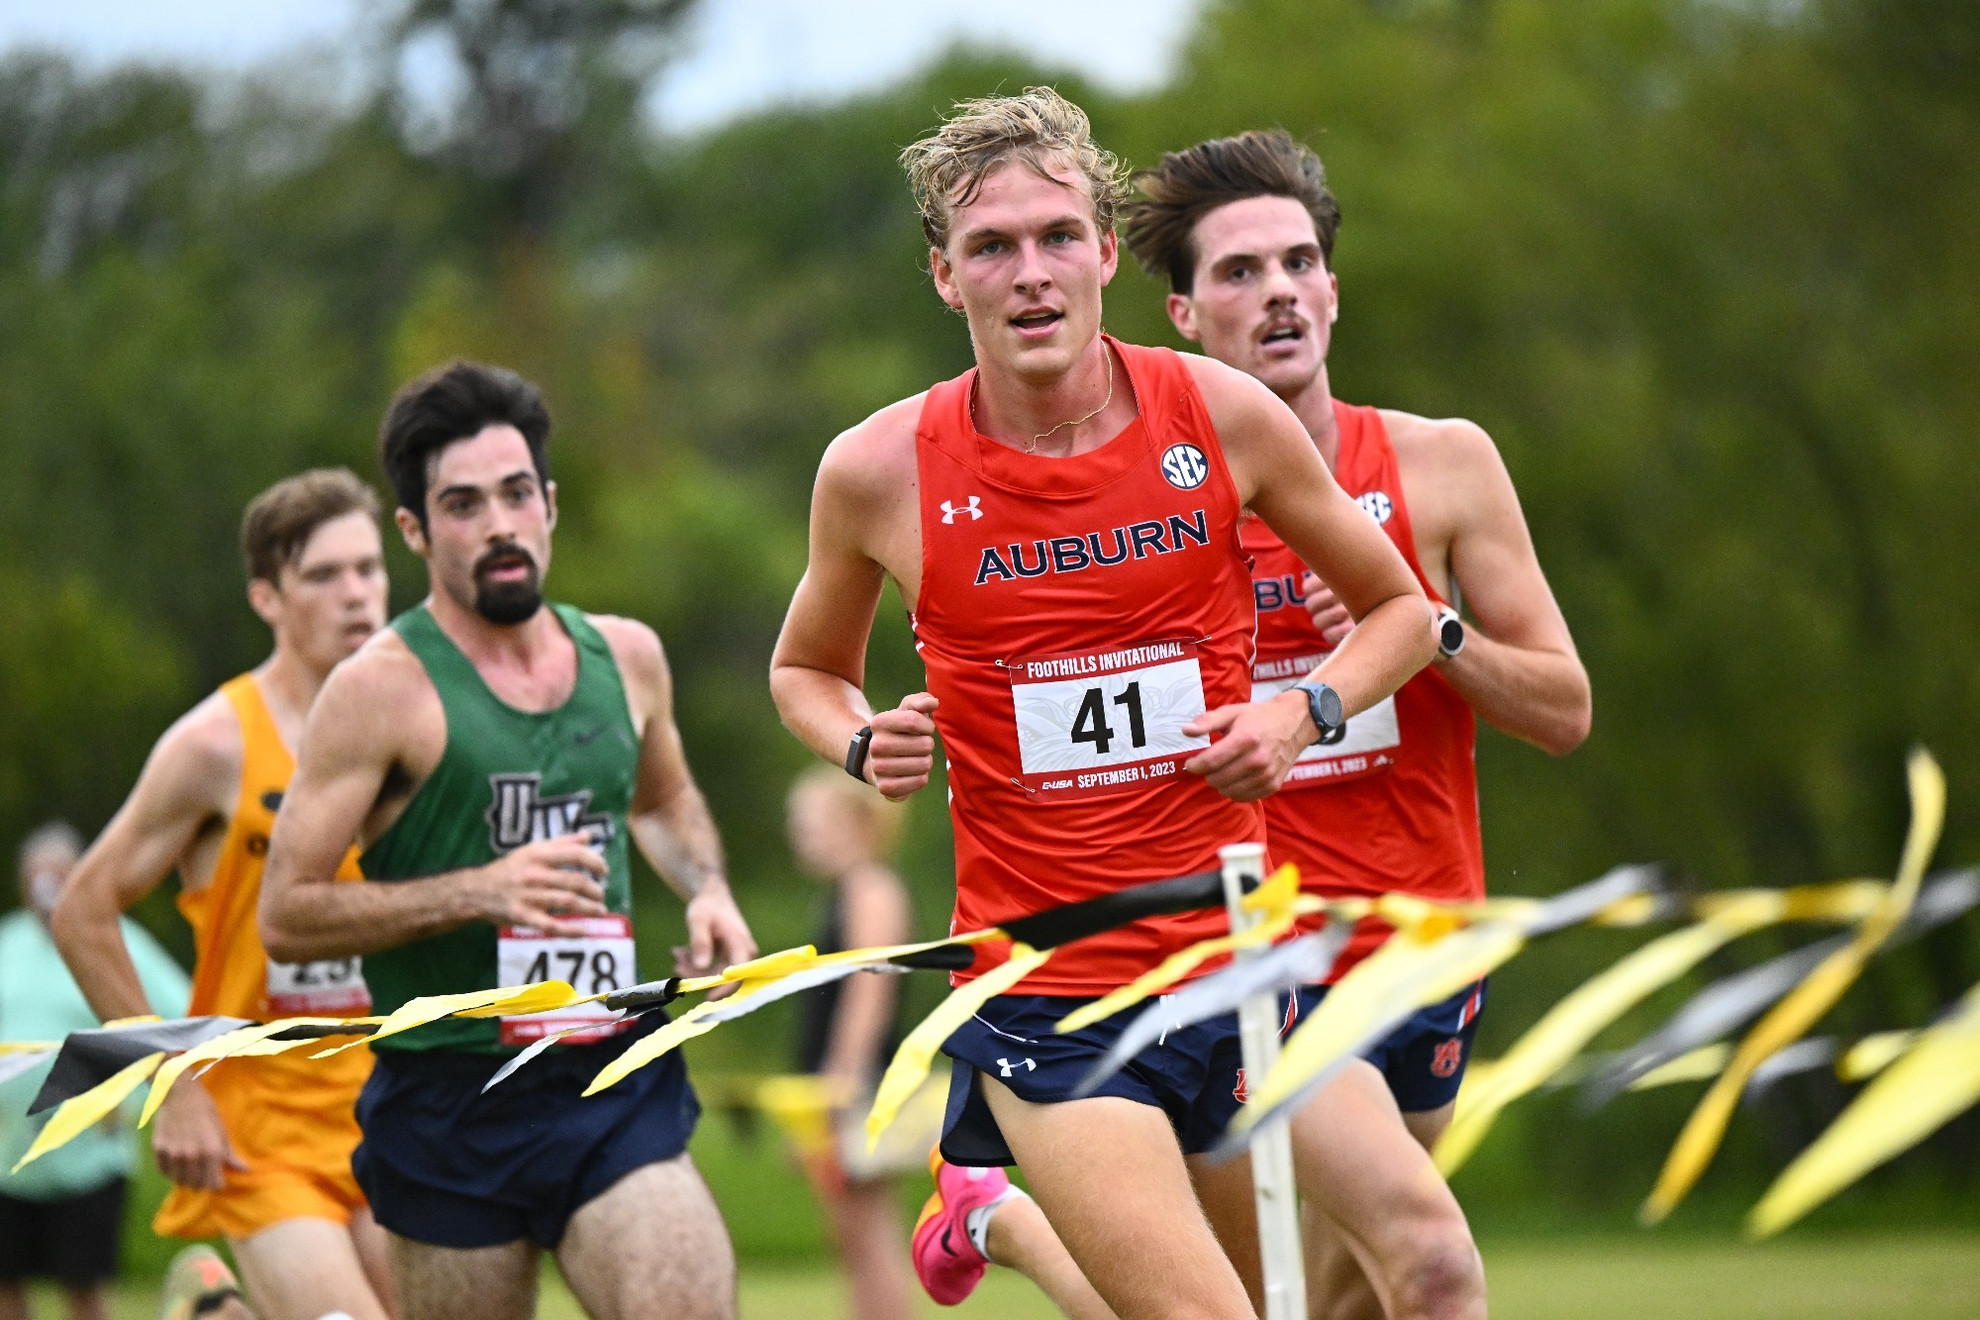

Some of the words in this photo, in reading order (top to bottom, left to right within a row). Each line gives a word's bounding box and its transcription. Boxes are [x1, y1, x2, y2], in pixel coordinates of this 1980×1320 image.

[1162, 445, 1207, 488] SEC
[974, 509, 1209, 585] AUBURN
[1027, 655, 1097, 678] FOOTHILLS
[1099, 641, 1184, 671] INVITATIONAL
[1071, 681, 1146, 754] 41
[1077, 767, 1141, 788] SEPTEMBER
[1140, 767, 1149, 780] 1,
[1150, 761, 1176, 777] 2023
[523, 951, 618, 1005] 478
